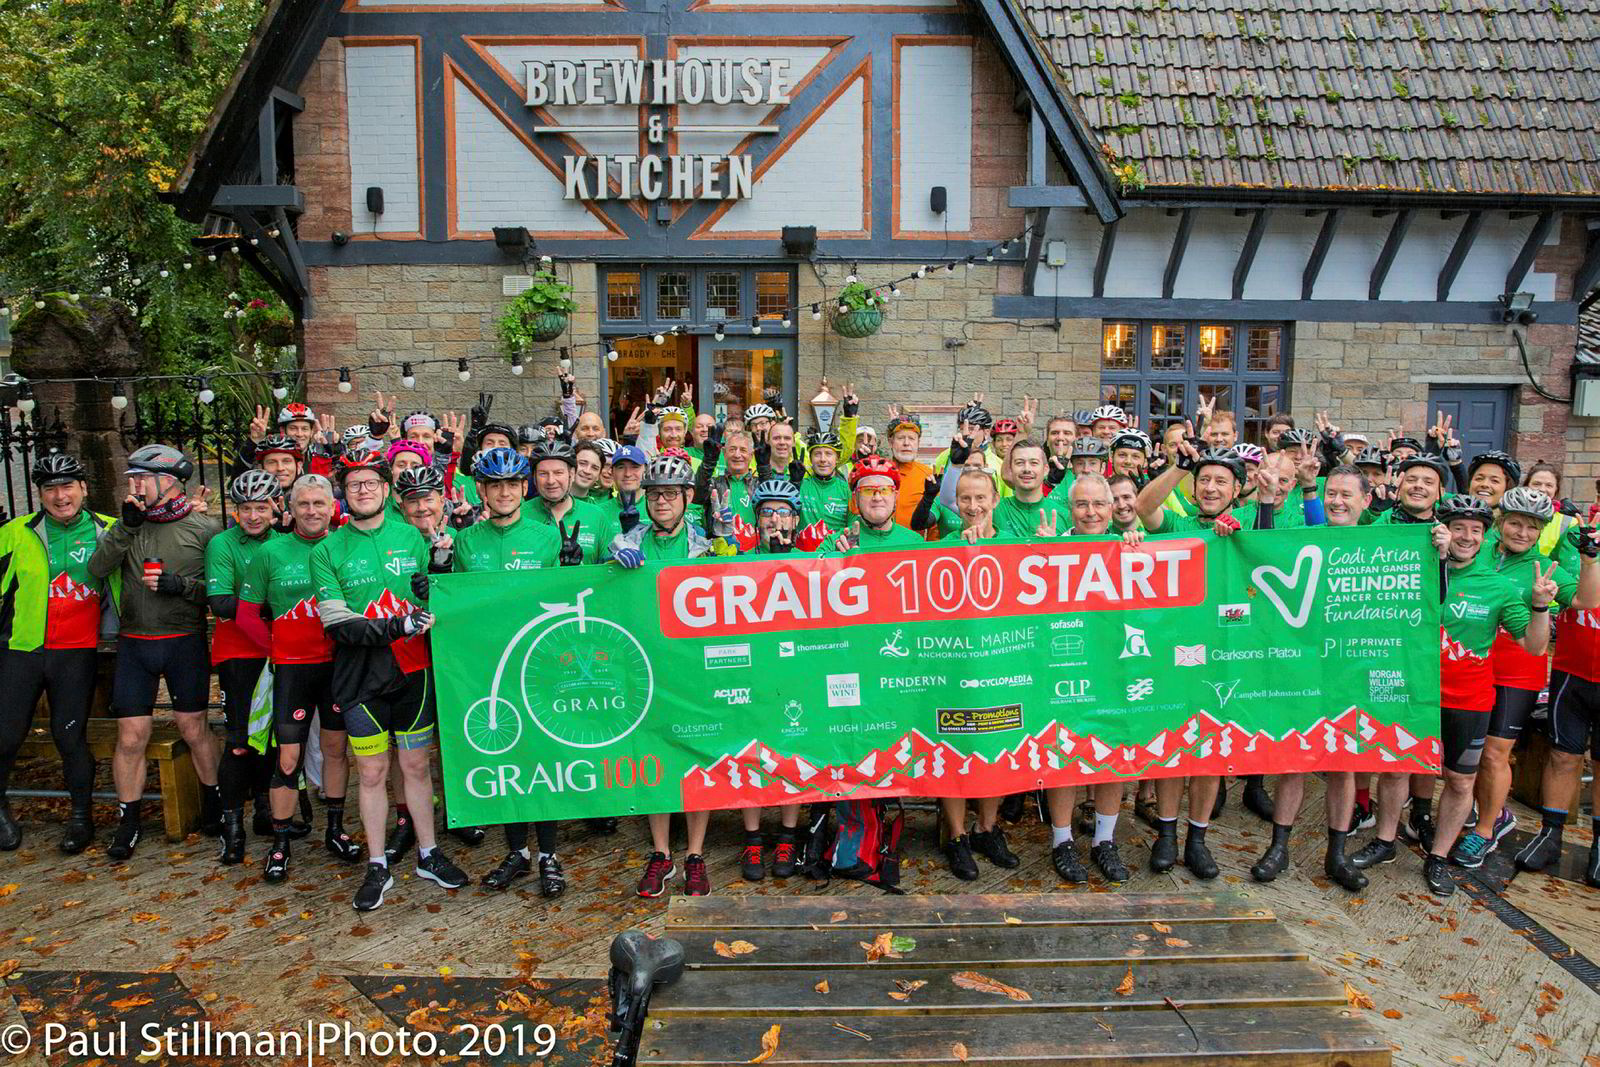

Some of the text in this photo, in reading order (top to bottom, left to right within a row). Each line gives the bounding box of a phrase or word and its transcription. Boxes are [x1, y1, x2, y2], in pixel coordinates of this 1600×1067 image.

[523, 58, 790, 106] BREWHOUSE
[649, 115, 663, 143] &
[563, 154, 752, 200] KITCHEN
[1328, 546, 1421, 566] Codi Arian
[1327, 563, 1421, 575] CANOLFAN GANSER
[673, 550, 1191, 627] GRAIG 100 START
[1327, 574, 1421, 593] VELINDRE
[1326, 592, 1421, 602] CANCER CENTRE
[1324, 603, 1422, 627] Fundraising
[1050, 619, 1084, 629] sofasofa
[916, 626, 1035, 650] IDWAL MARINE
[1346, 638, 1402, 647] JP PRIVATE
[797, 640, 849, 652] thomascarroll
[970, 650, 989, 658] YOUR
[991, 641, 1035, 656] INVESTMENTS
[1211, 647, 1301, 661] Clarksons Platou
[1346, 649, 1389, 658] CLIENTS
[709, 657, 748, 665] PARTNERS
[1369, 670, 1402, 679] MORGAN
[880, 675, 947, 689] PENDERYN
[980, 675, 1033, 687] CYCLOPAEDIA
[1369, 679, 1405, 687] WILLIAMS
[714, 688, 751, 698] ACUITY
[832, 689, 857, 697] WINE
[1055, 679, 1091, 697] CLP
[1233, 688, 1323, 700] Campbell Johnston Clark
[1369, 686, 1394, 695] SPORT
[552, 695, 626, 713] GRAIG
[1369, 694, 1410, 703] THERAPIST
[671, 722, 724, 734] Outsmart
[829, 721, 897, 734] HUGH JAMES
